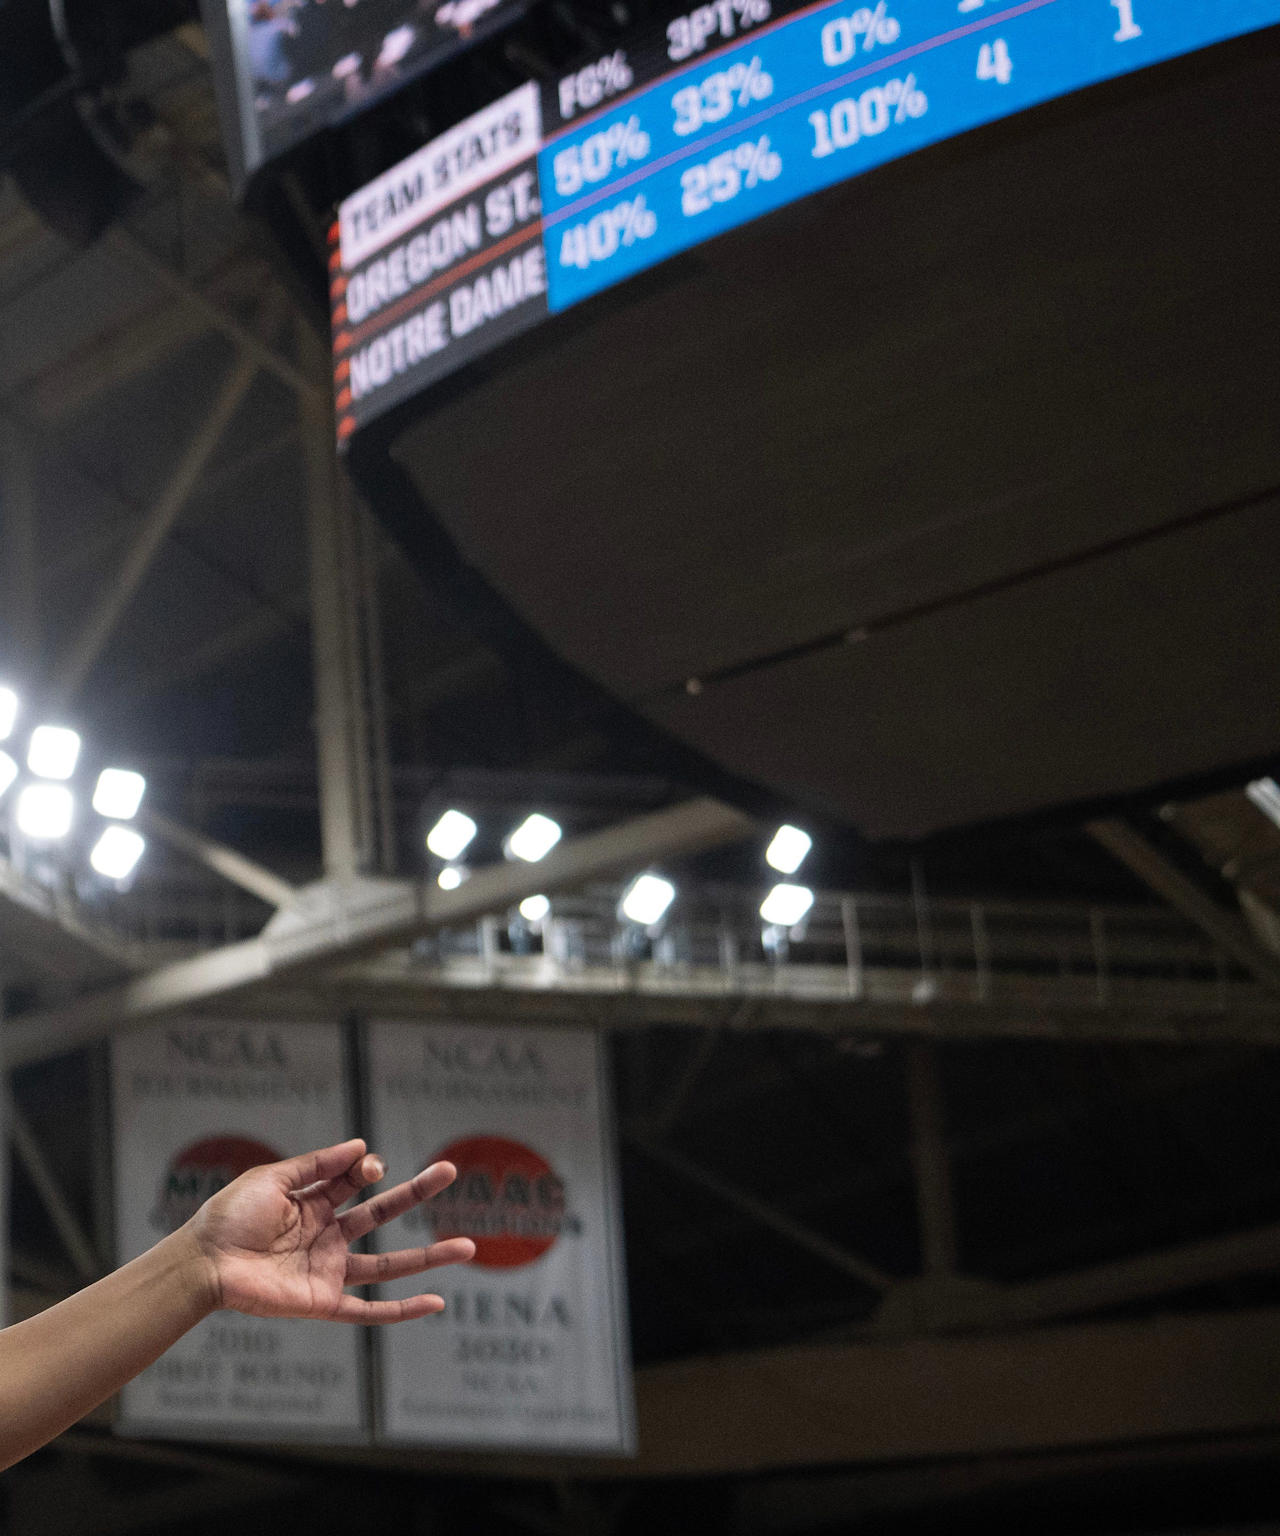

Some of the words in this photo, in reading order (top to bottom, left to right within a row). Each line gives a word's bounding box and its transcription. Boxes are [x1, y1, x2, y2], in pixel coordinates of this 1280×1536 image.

[345, 210, 479, 323] OREGON
[486, 170, 540, 238] ST.
[554, 115, 650, 196] 50%
[671, 55, 773, 136] 33%
[821, 1, 900, 66] 0%
[347, 178, 423, 240] TEAM
[427, 108, 522, 190] STATS
[558, 48, 633, 118] FG%
[349, 307, 444, 399] NOTRE
[450, 248, 546, 337] DAME
[559, 194, 658, 269] 40%
[681, 135, 782, 216] 25%
[808, 72, 928, 158] 100%
[975, 38, 1014, 85] 4
